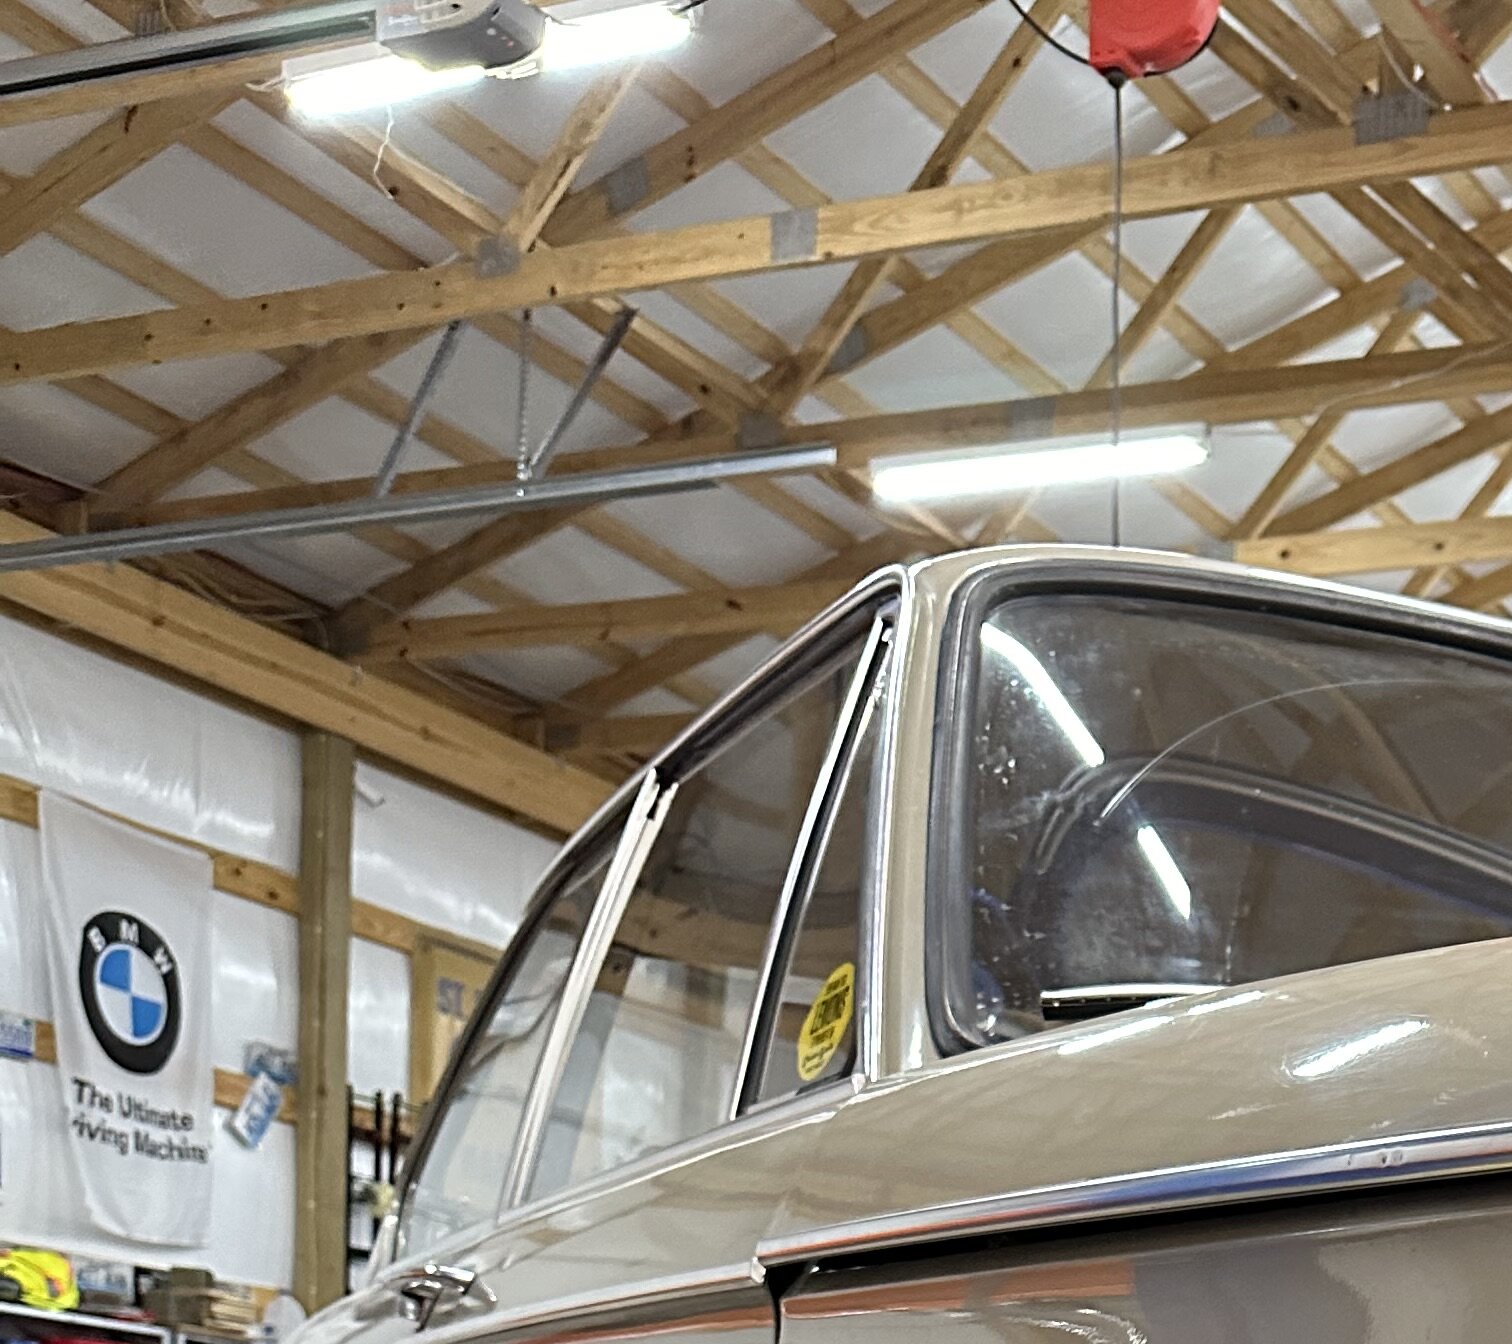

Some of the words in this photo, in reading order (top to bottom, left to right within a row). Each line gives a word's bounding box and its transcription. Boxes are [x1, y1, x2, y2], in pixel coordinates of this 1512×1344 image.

[87, 918, 173, 974] BMW
[71, 1076, 113, 1114] The
[118, 1090, 194, 1132] Ultimate
[73, 1113, 129, 1156] iving
[134, 1129, 208, 1163] Machine
